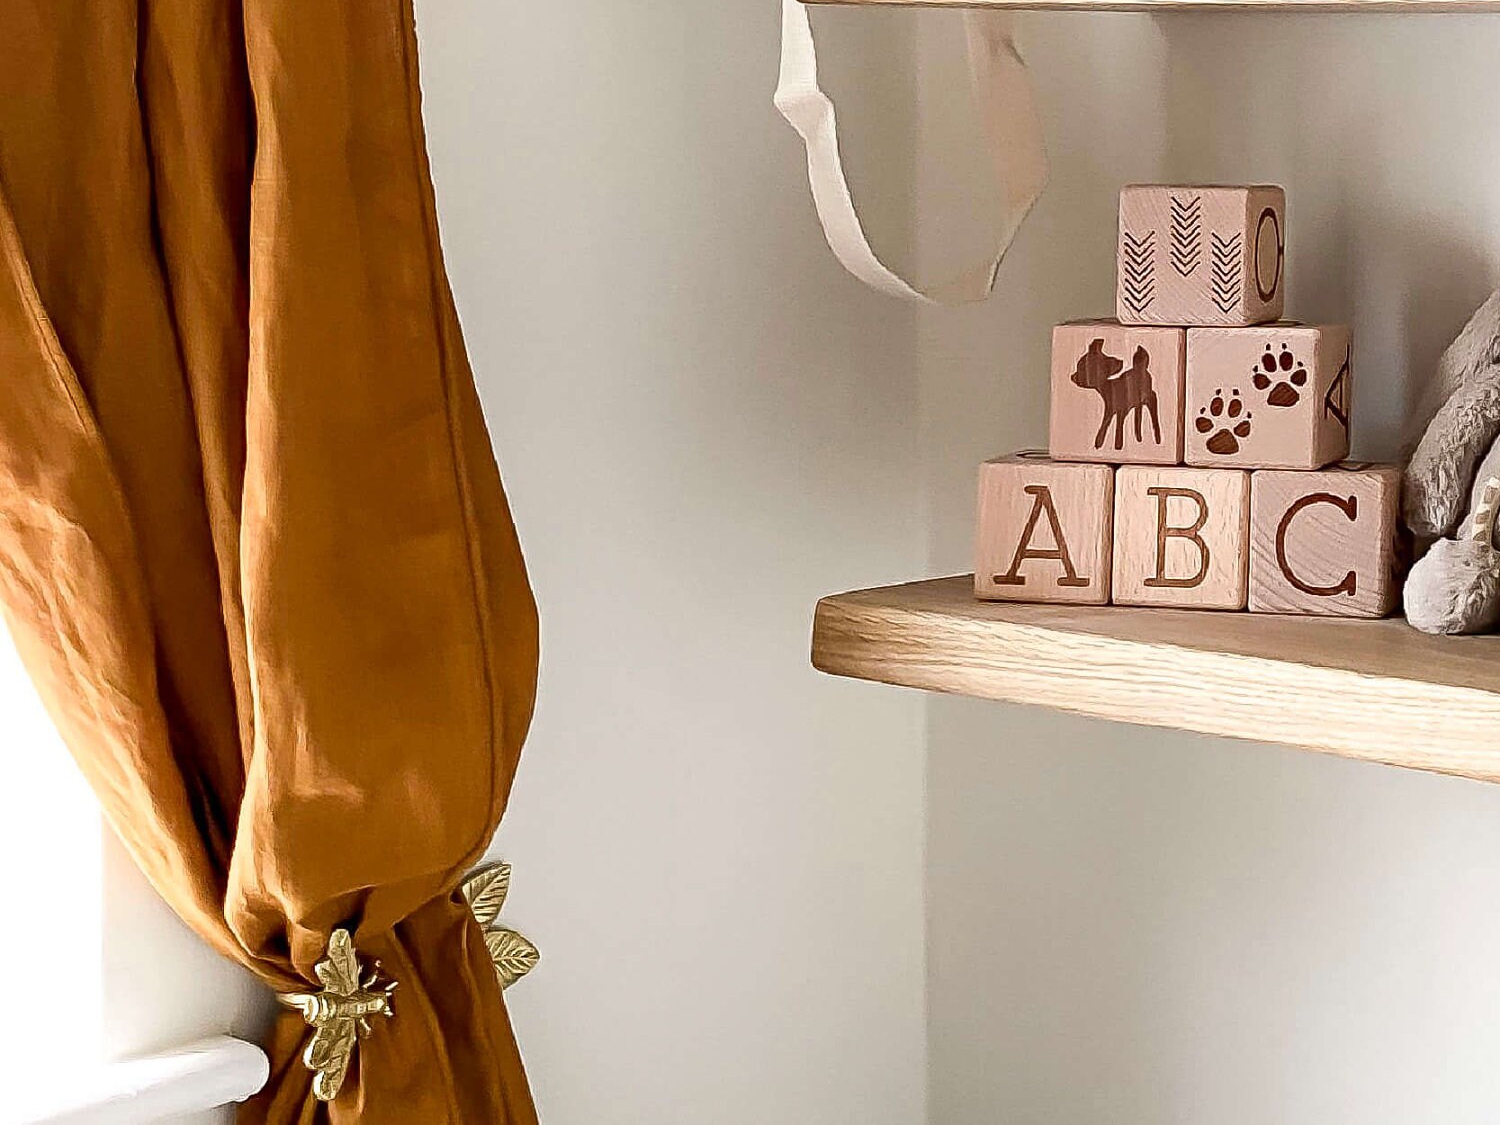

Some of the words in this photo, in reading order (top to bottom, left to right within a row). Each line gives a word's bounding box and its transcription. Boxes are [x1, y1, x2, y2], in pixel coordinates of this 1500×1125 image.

[993, 485, 1090, 588] A
[1144, 486, 1211, 588] B
[1275, 492, 1358, 597] C
